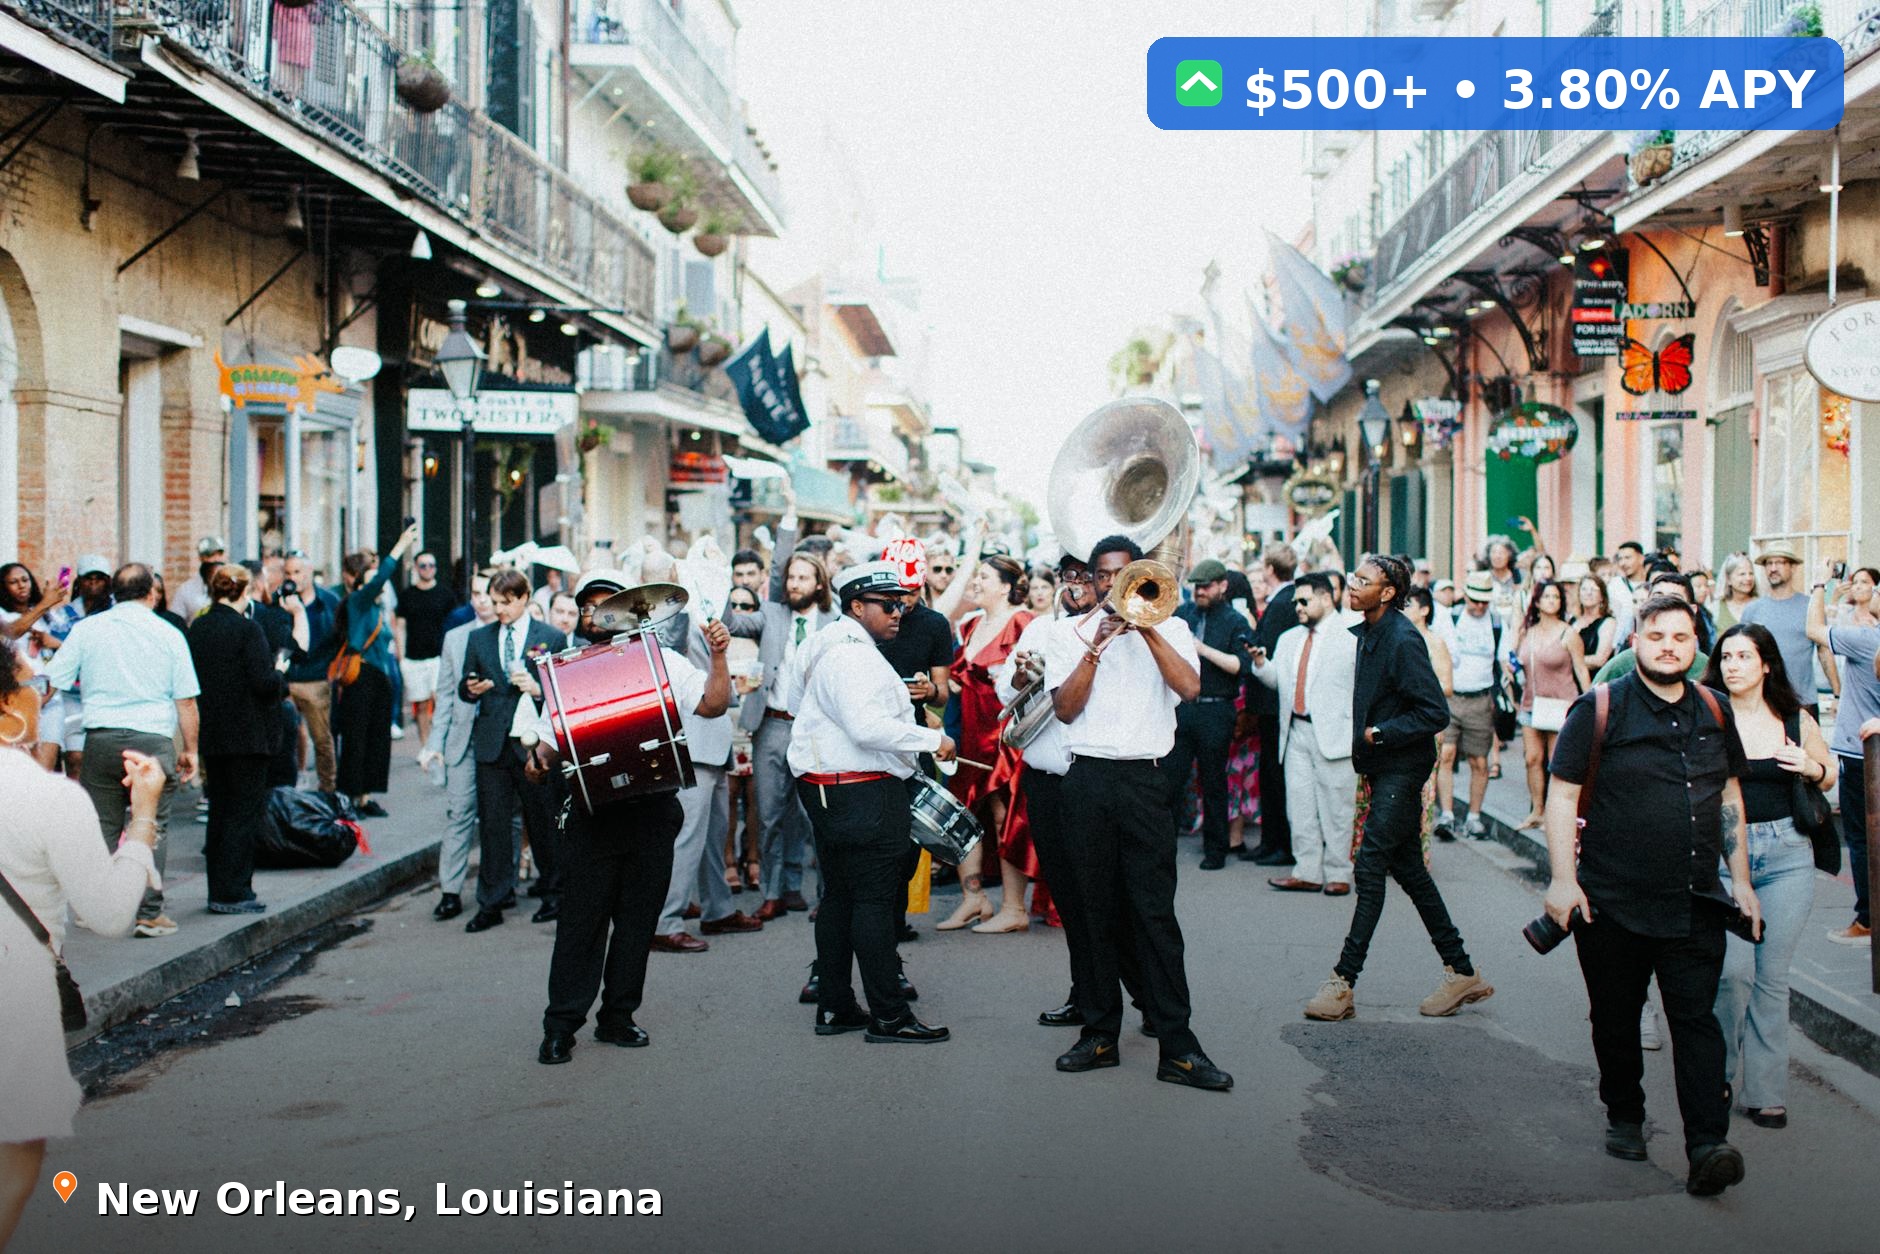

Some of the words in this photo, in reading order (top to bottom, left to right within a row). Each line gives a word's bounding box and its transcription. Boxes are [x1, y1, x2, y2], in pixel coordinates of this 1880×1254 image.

[1620, 303, 1689, 318] ADORN
[1576, 324, 1595, 335] FOR
[417, 408, 464, 422] TWO
